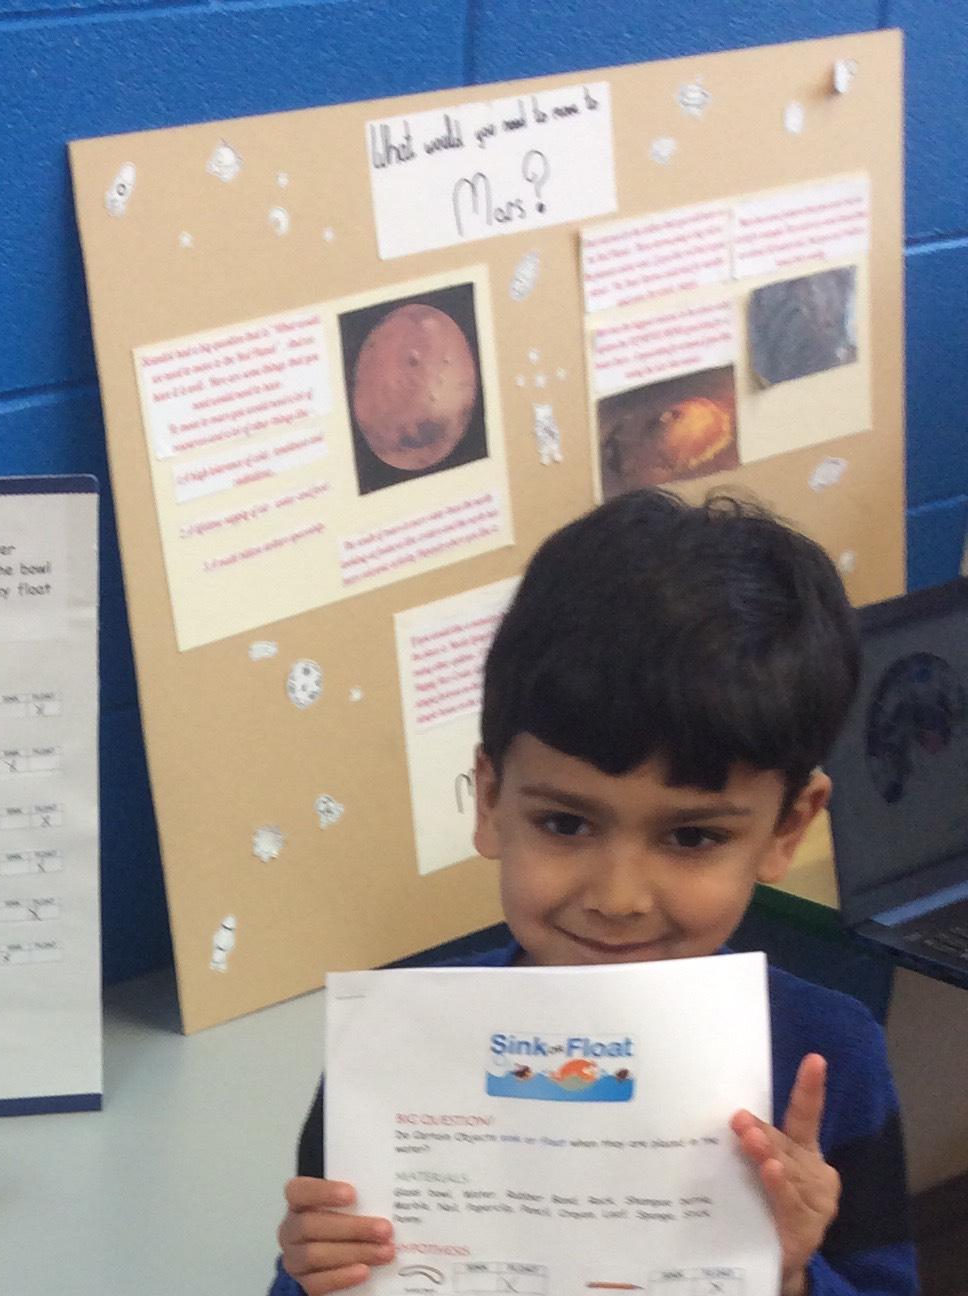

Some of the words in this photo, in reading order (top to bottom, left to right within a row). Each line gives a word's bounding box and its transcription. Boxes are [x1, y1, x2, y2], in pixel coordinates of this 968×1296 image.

[18, 561, 51, 576] bowl
[17, 582, 51, 598] float
[490, 1033, 548, 1057] Sink
[566, 1036, 632, 1057] Float
